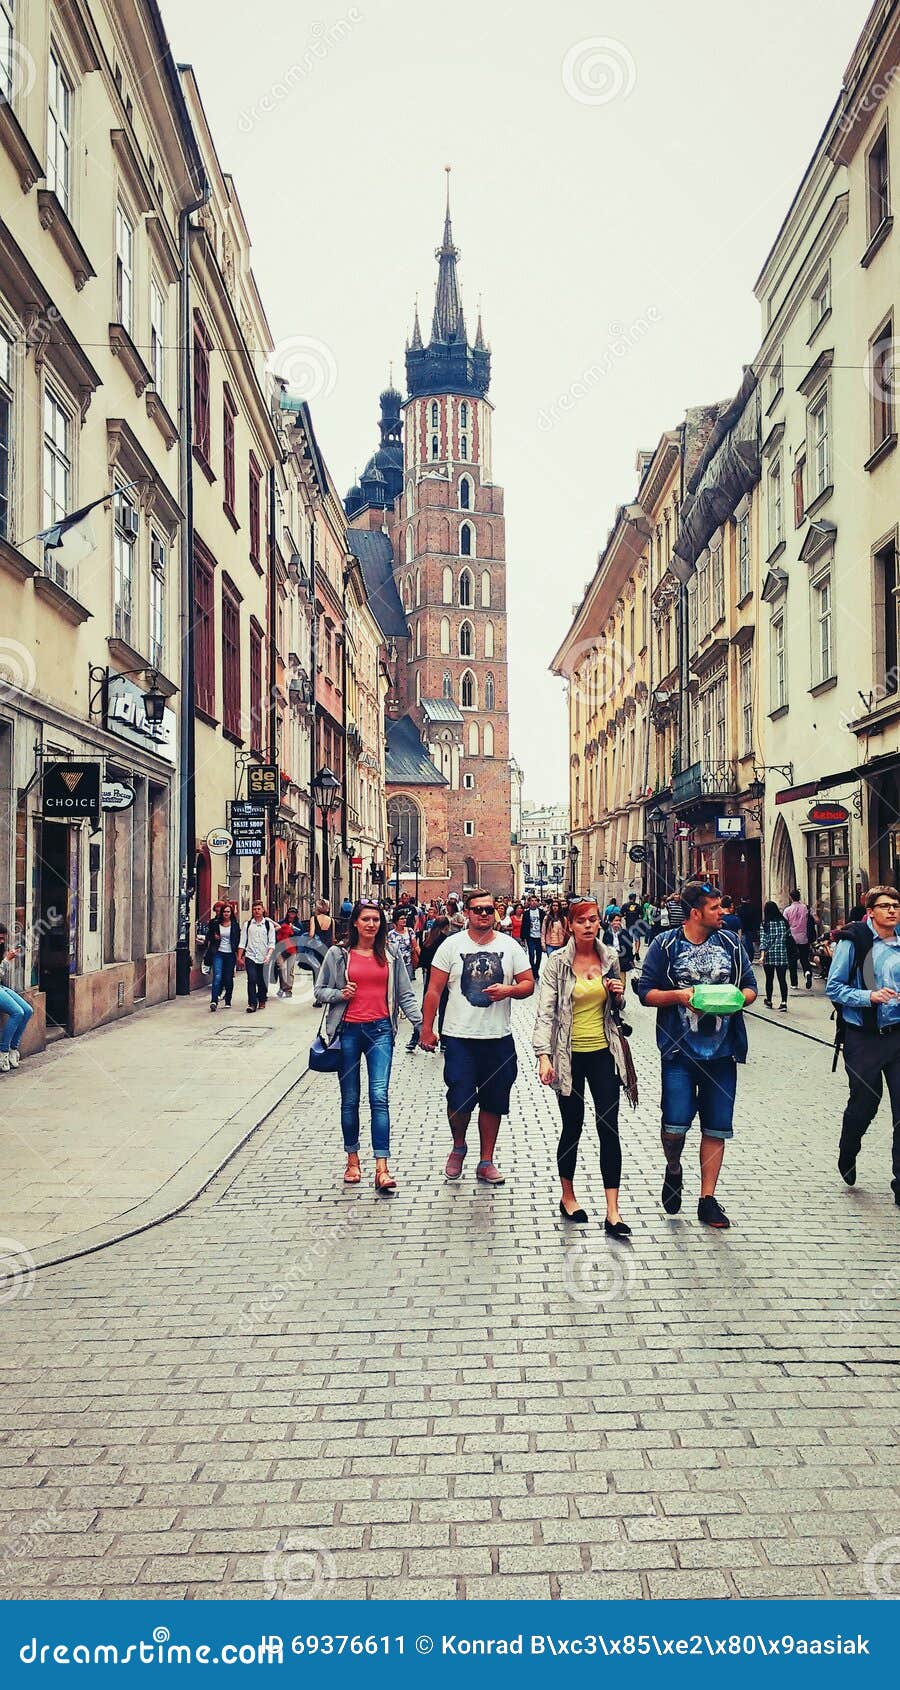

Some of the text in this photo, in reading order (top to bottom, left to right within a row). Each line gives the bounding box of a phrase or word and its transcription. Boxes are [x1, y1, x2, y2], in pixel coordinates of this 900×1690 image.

[251, 769, 275, 781] de
[251, 781, 275, 791] sa
[46, 798, 96, 807] CHOICE
[235, 840, 262, 848] KANTOR
